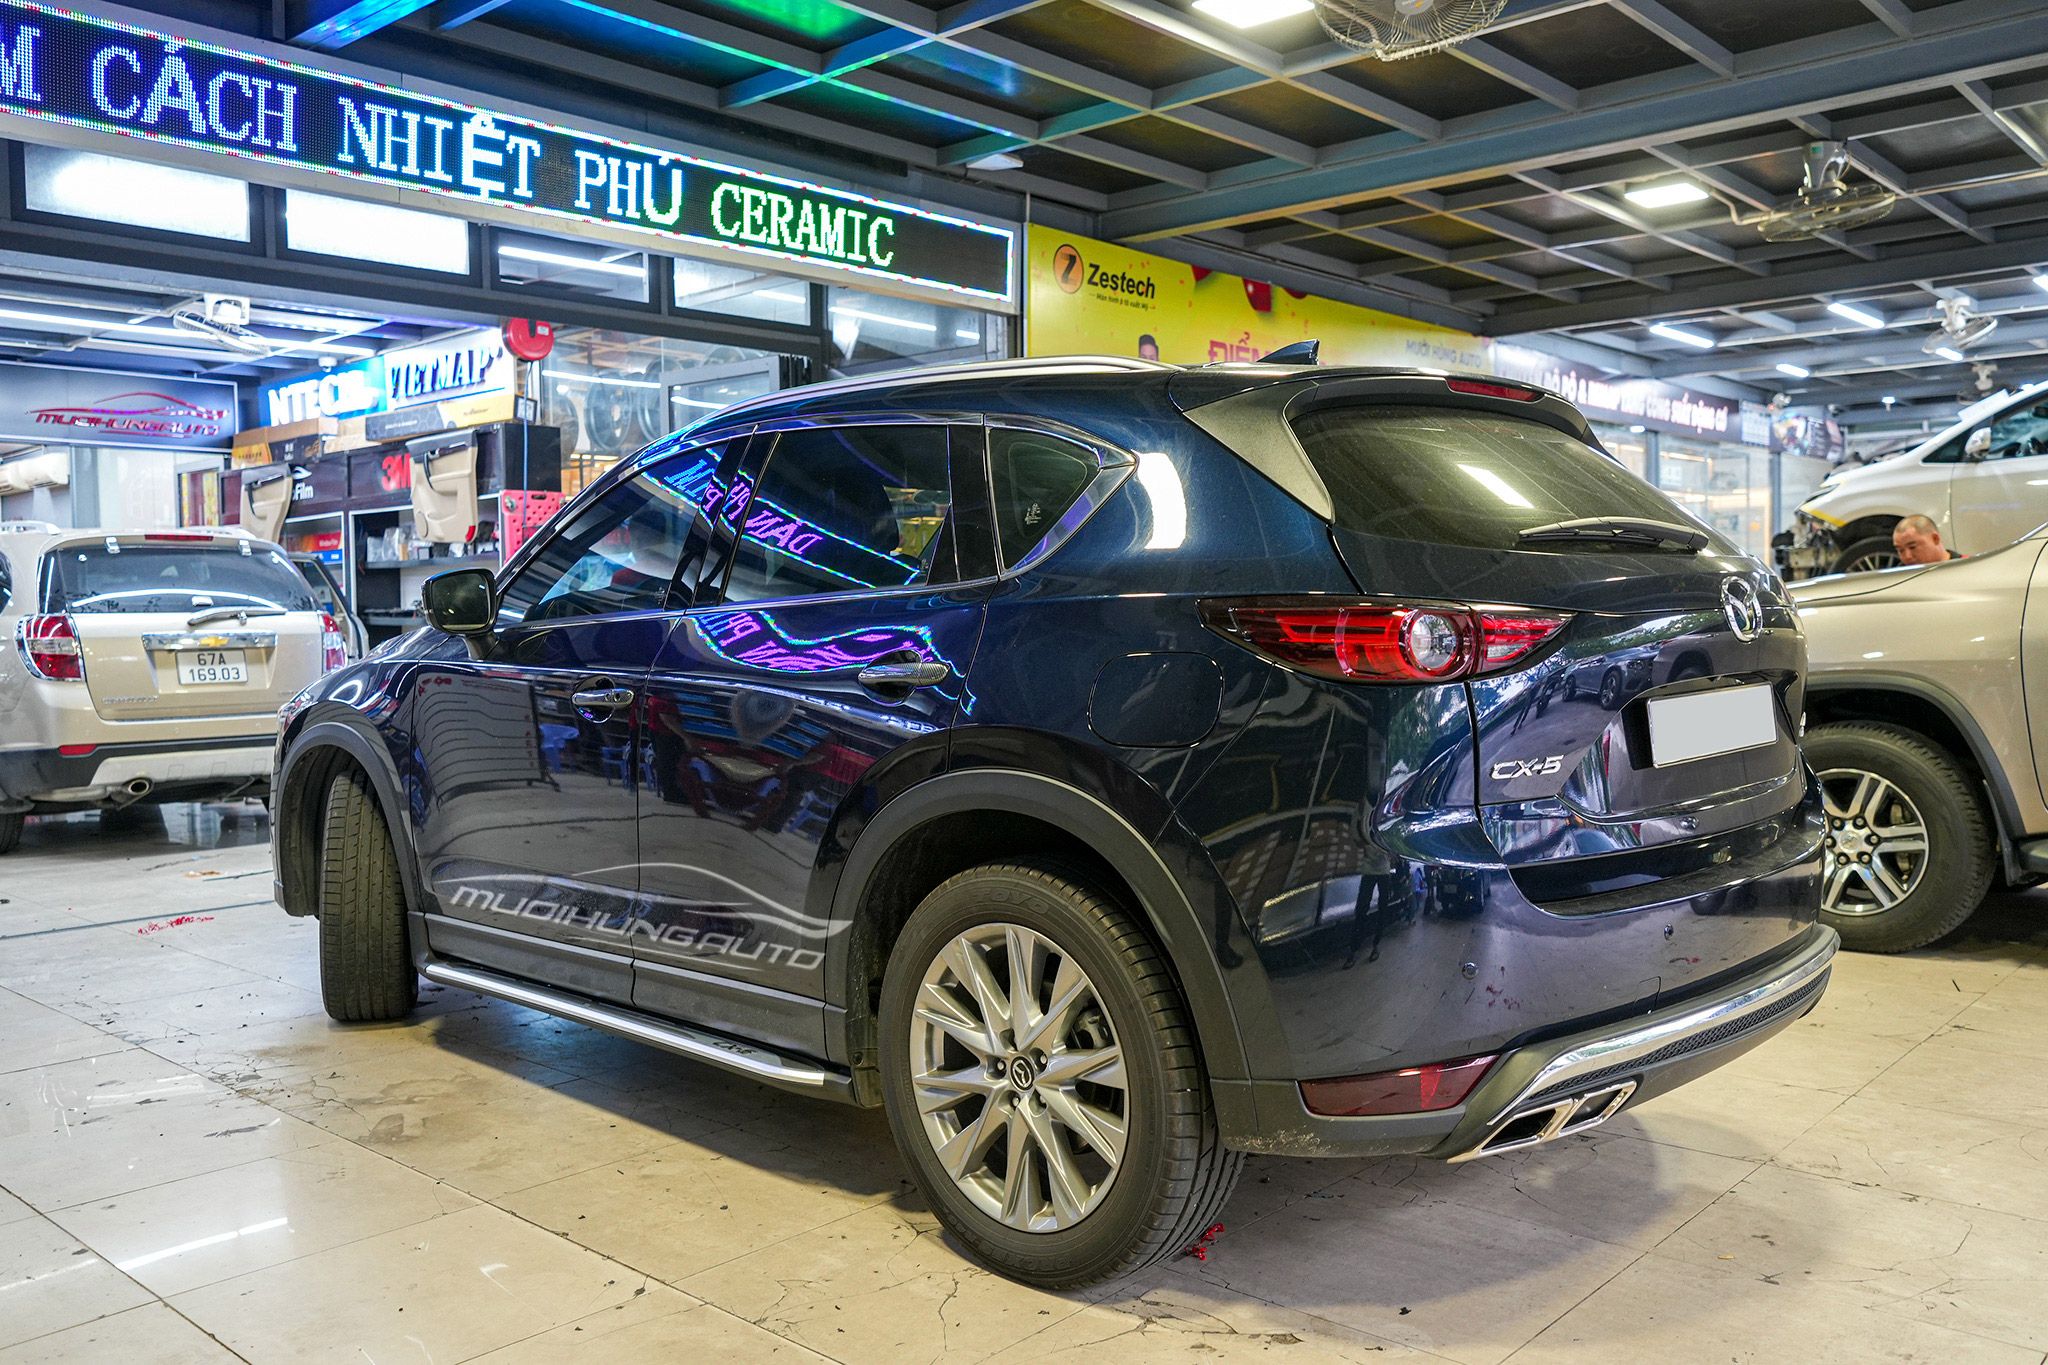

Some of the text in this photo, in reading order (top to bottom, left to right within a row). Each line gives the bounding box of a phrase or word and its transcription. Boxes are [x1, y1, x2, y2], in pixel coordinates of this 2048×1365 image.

[92, 41, 297, 151] CÁCH
[338, 96, 541, 201] NHIỆT
[712, 182, 894, 267] CERAMIC
[1087, 262, 1156, 299] Zestech
[391, 347, 497, 400] VIETMAP
[1459, 350, 1482, 369] AUTO
[381, 452, 411, 491] 3M
[189, 667, 240, 682] 169.03
[197, 653, 227, 666] 67A
[1491, 755, 1564, 779] CX-5
